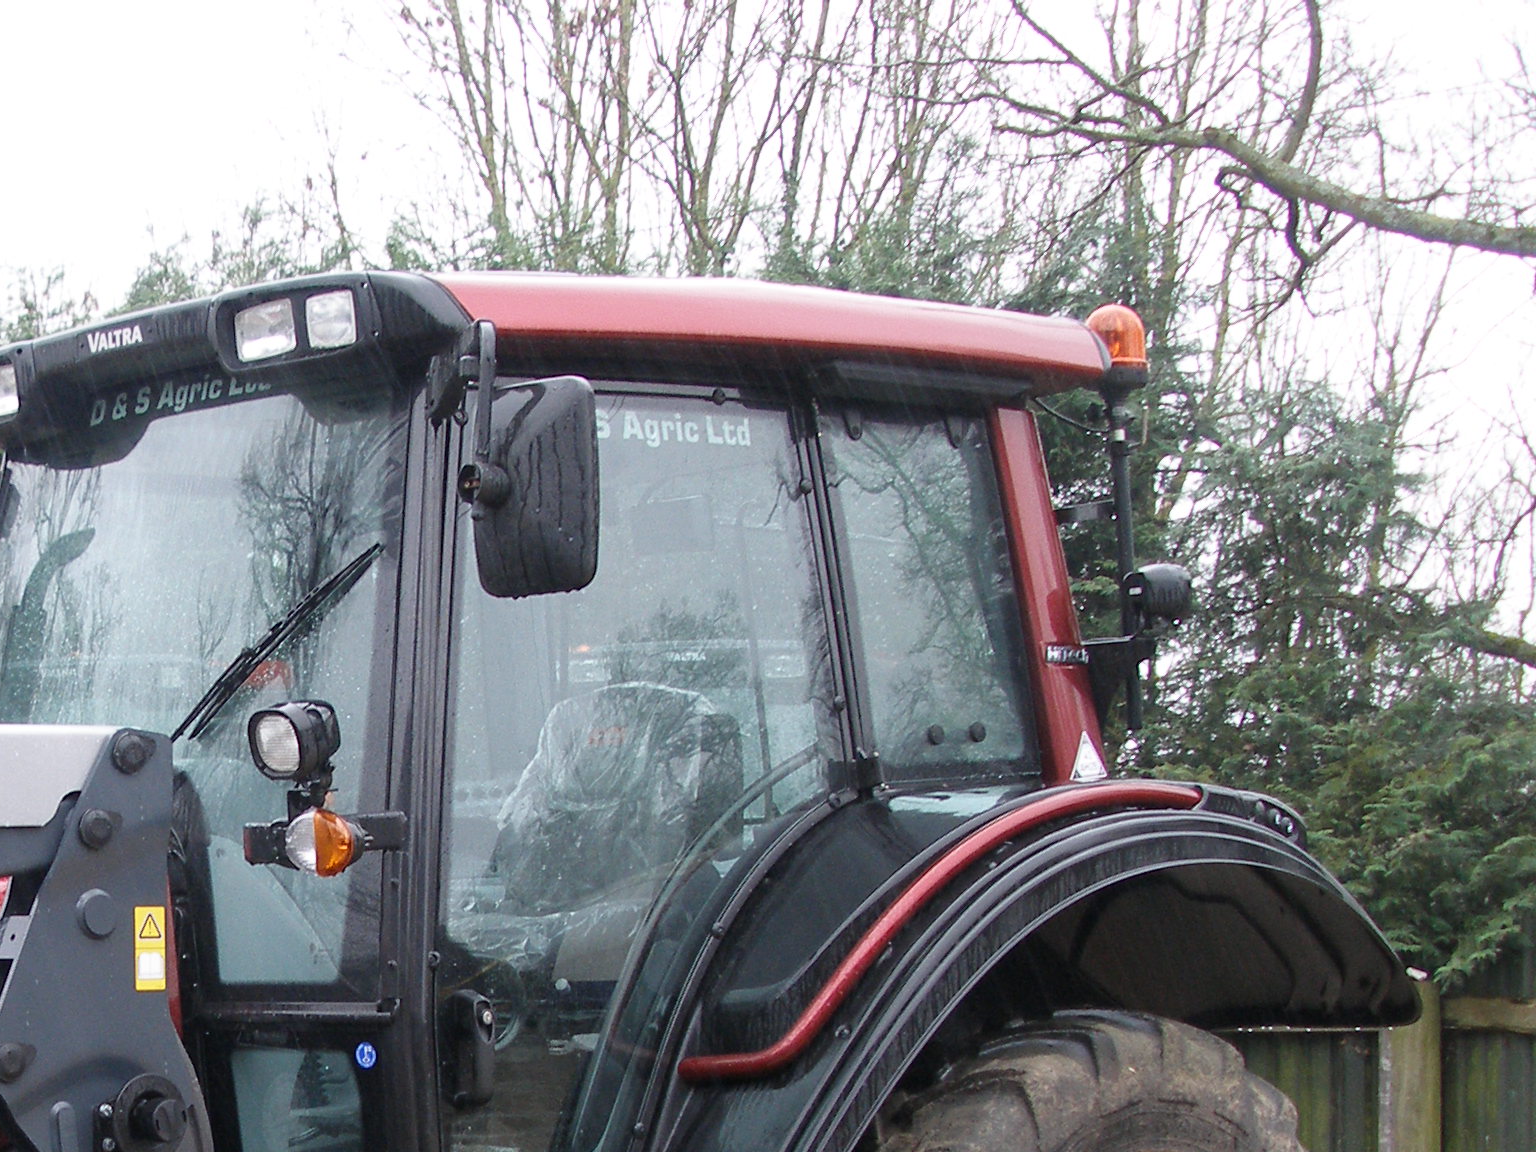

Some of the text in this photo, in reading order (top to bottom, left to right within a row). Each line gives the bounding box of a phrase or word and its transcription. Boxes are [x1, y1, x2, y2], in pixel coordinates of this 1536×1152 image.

[87, 324, 143, 353] VALTRA
[90, 398, 105, 427] D
[111, 392, 128, 421] &
[134, 385, 152, 415] S
[157, 374, 223, 412] Agric
[623, 411, 700, 448] Agric
[705, 415, 752, 447] Ltd
